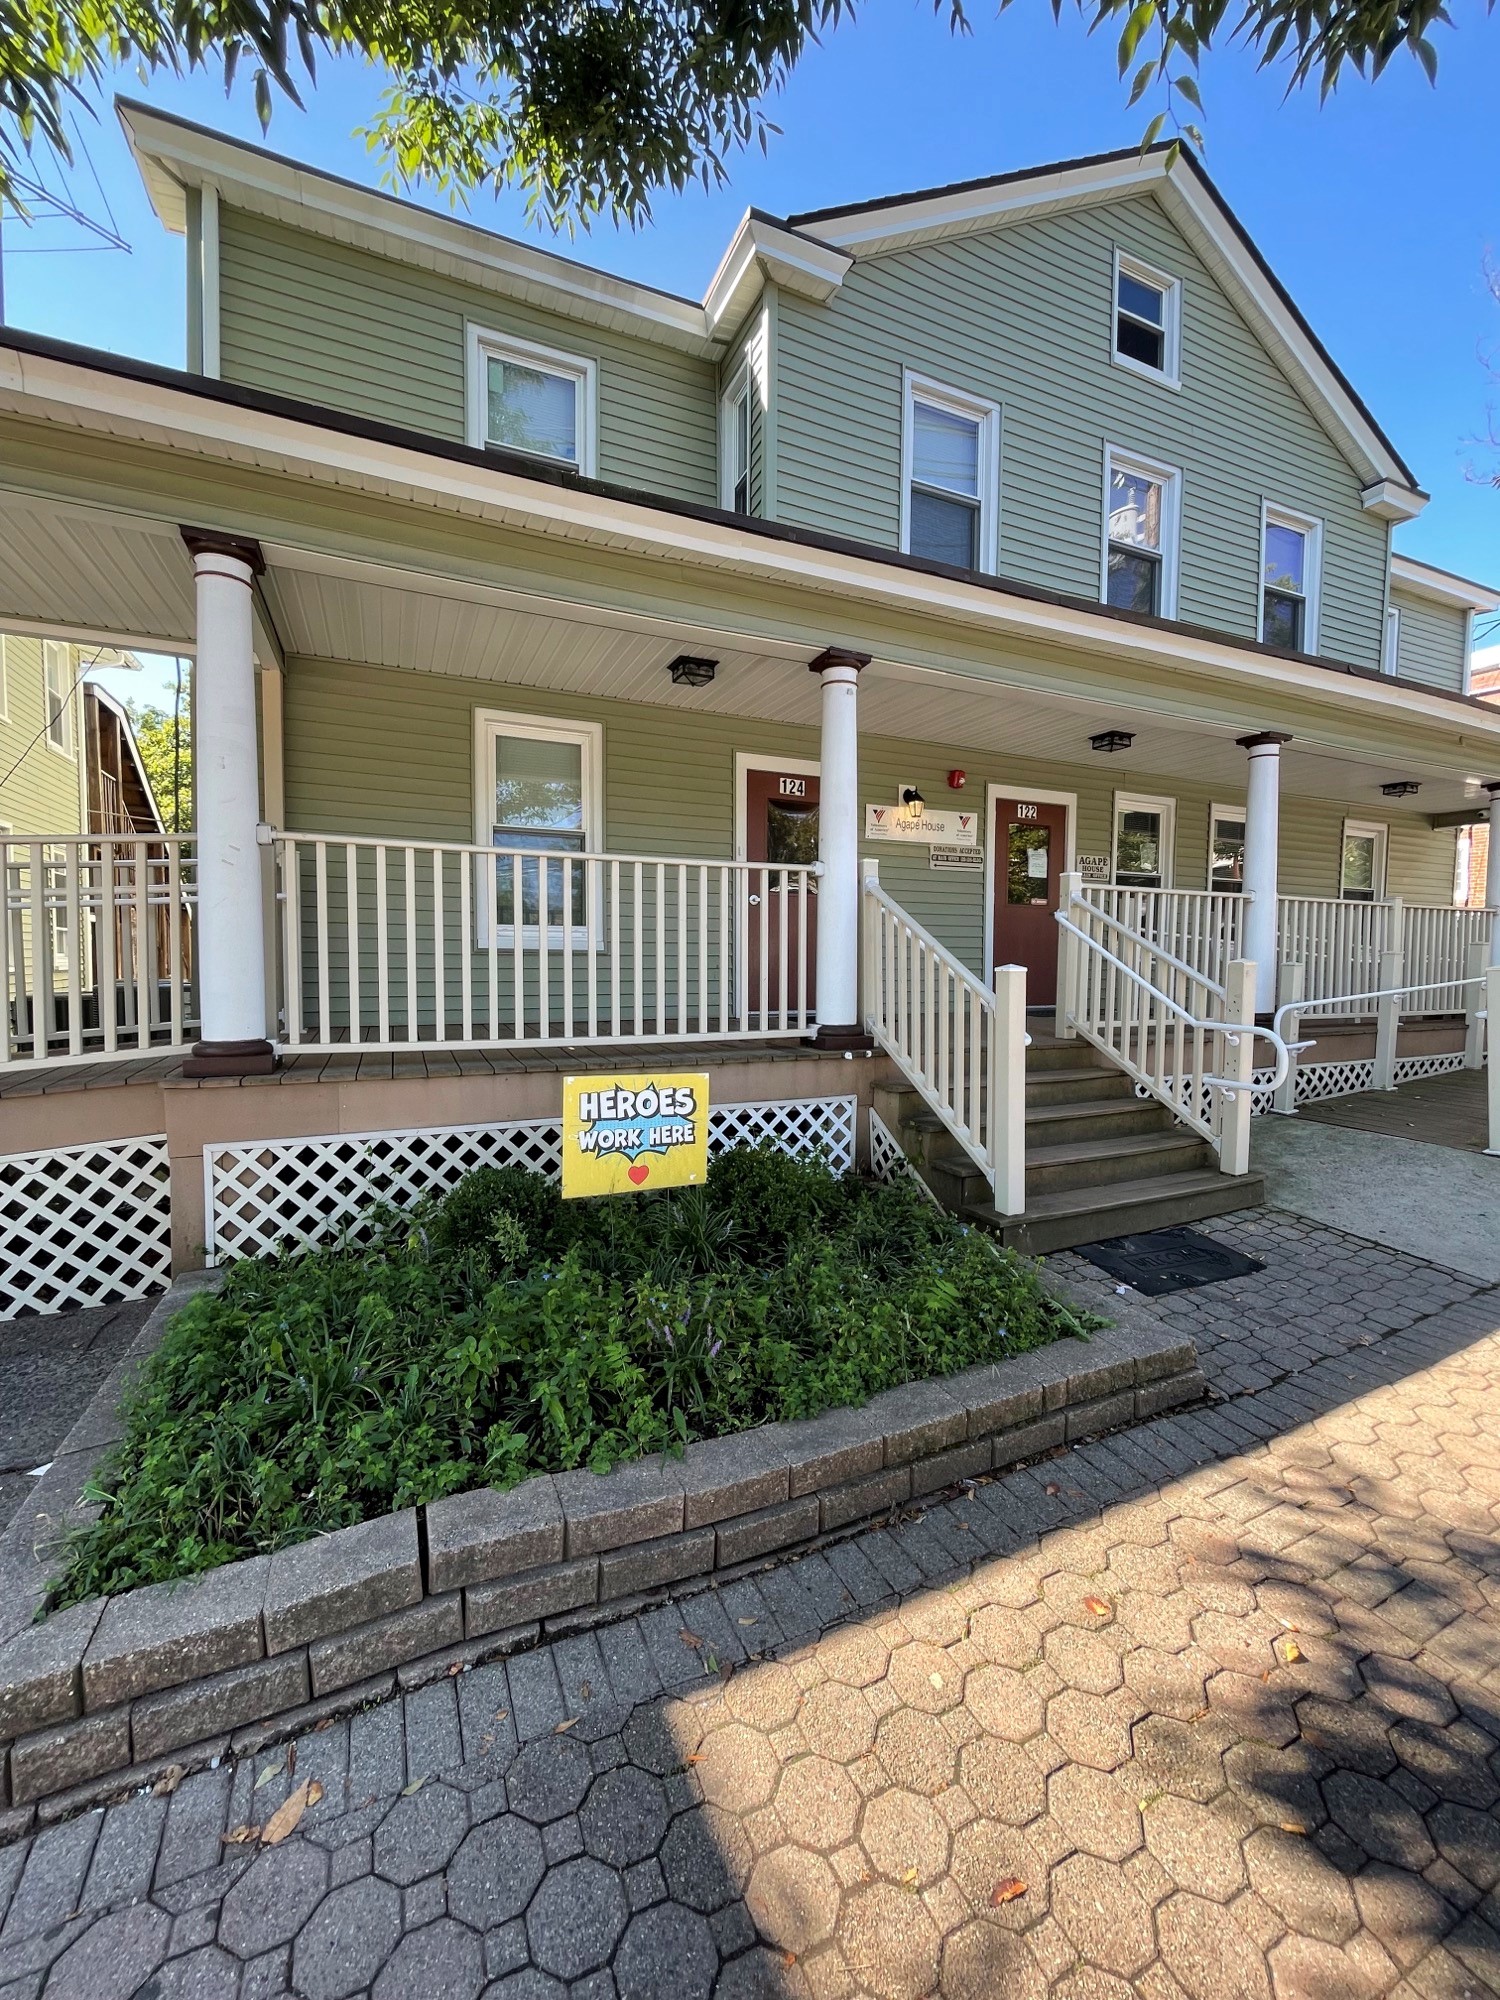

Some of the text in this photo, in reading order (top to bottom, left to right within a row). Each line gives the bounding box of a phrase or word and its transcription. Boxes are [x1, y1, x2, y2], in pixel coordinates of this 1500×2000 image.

[782, 779, 803, 795] 124
[1019, 806, 1036, 818] 122
[896, 818, 945, 832] Agapé House
[579, 1087, 697, 1122] HEROES
[578, 1123, 696, 1152] WORK HERE
